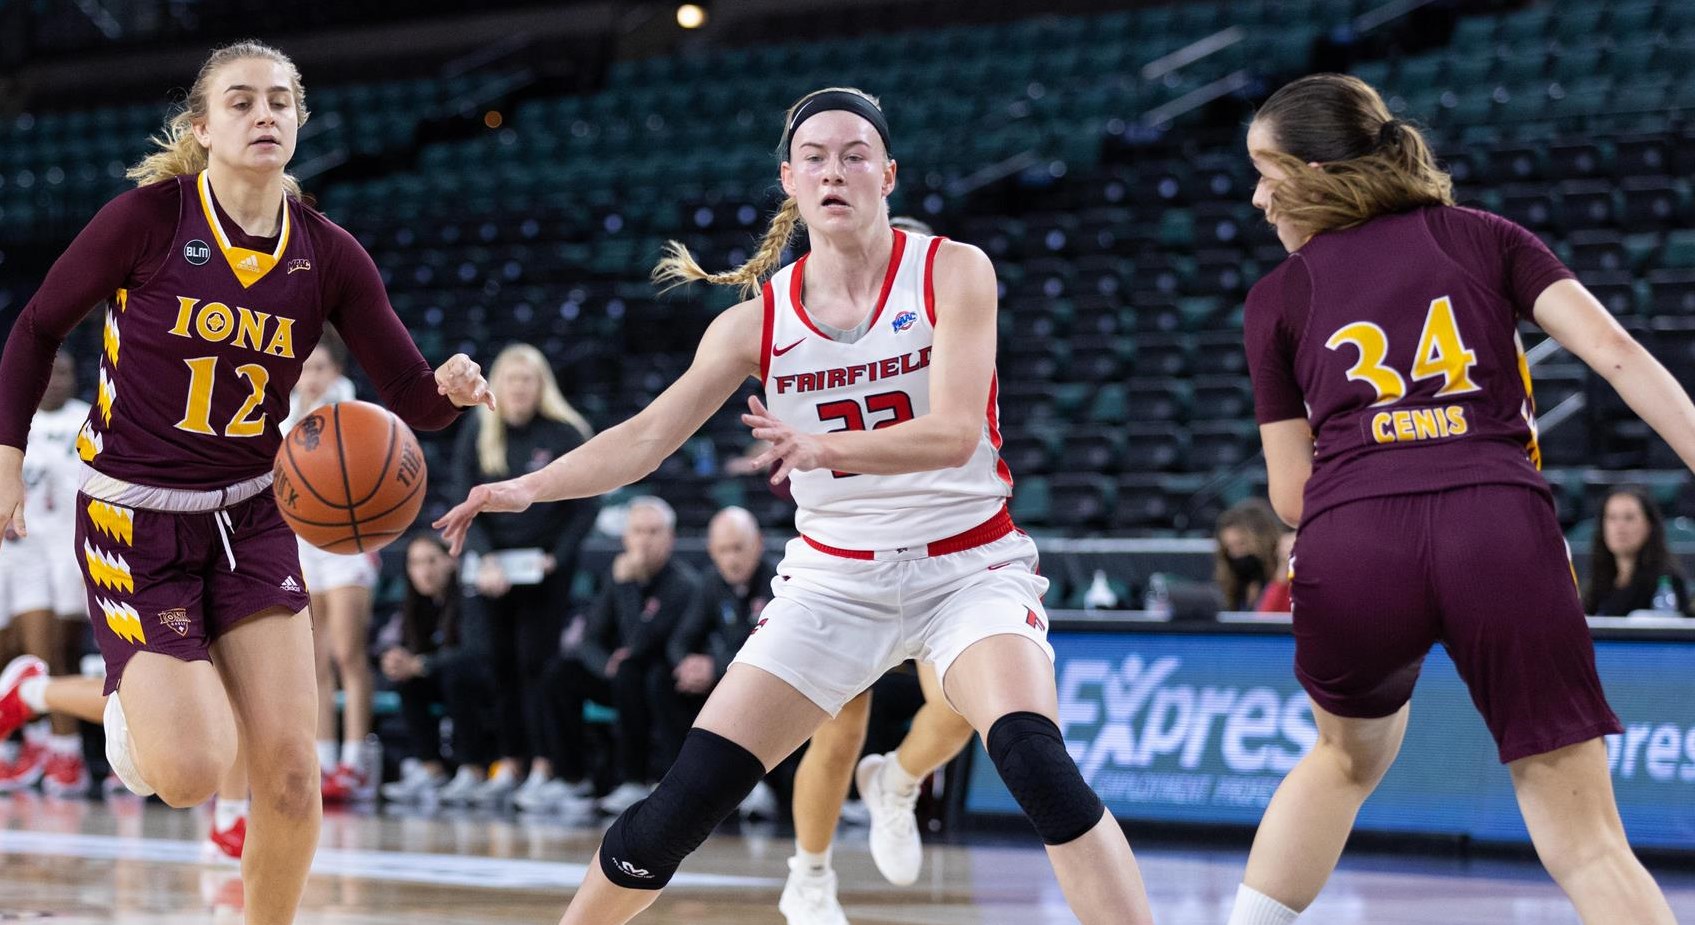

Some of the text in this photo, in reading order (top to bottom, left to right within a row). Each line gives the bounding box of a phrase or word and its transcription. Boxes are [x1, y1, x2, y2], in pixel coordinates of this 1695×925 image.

[186, 246, 208, 258] BLM
[168, 296, 296, 359] IONA
[1324, 295, 1482, 408] 34
[174, 356, 269, 438] 12
[1372, 406, 1468, 444] CENIS
